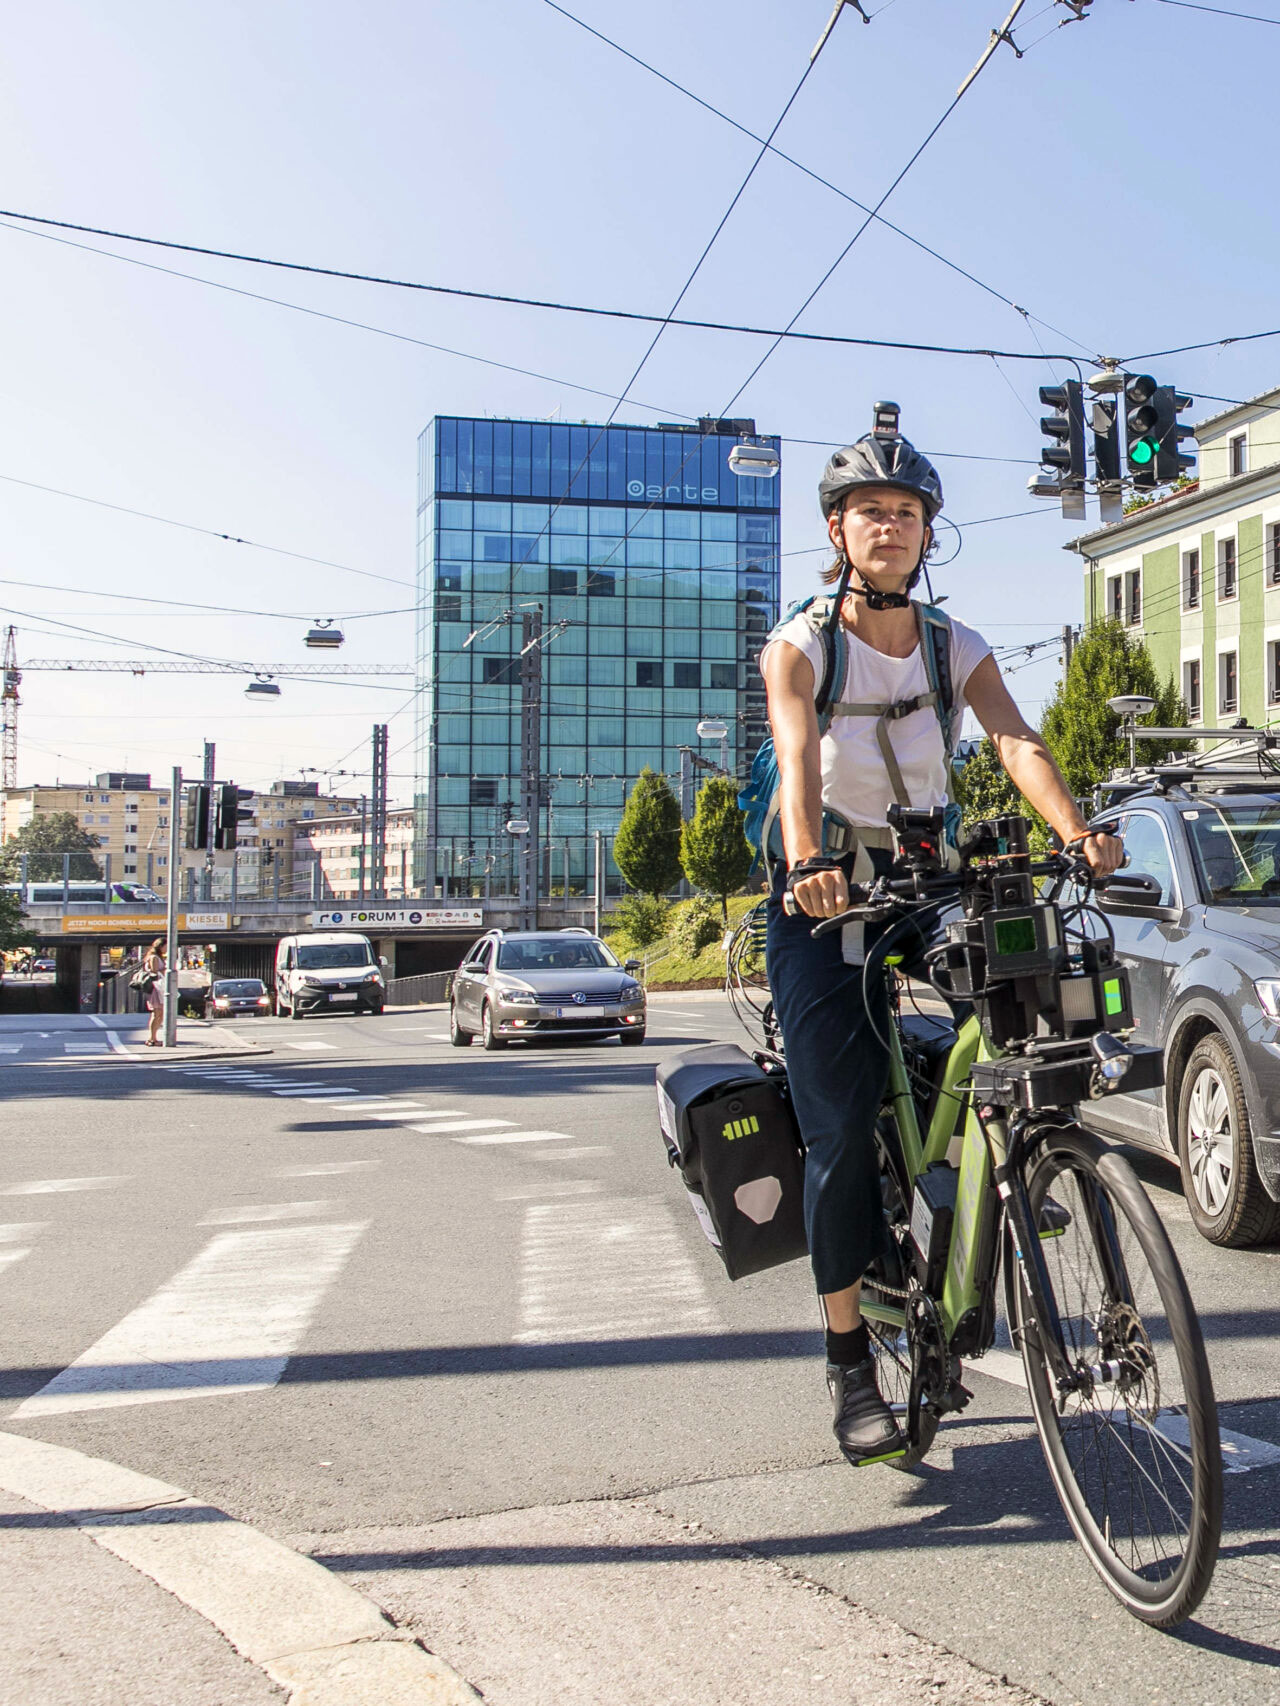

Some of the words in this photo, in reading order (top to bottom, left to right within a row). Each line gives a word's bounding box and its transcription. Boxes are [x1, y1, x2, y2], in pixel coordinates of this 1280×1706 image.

[189, 915, 225, 923] KIESEL
[351, 912, 396, 922] FORUM
[399, 912, 405, 921] 1
